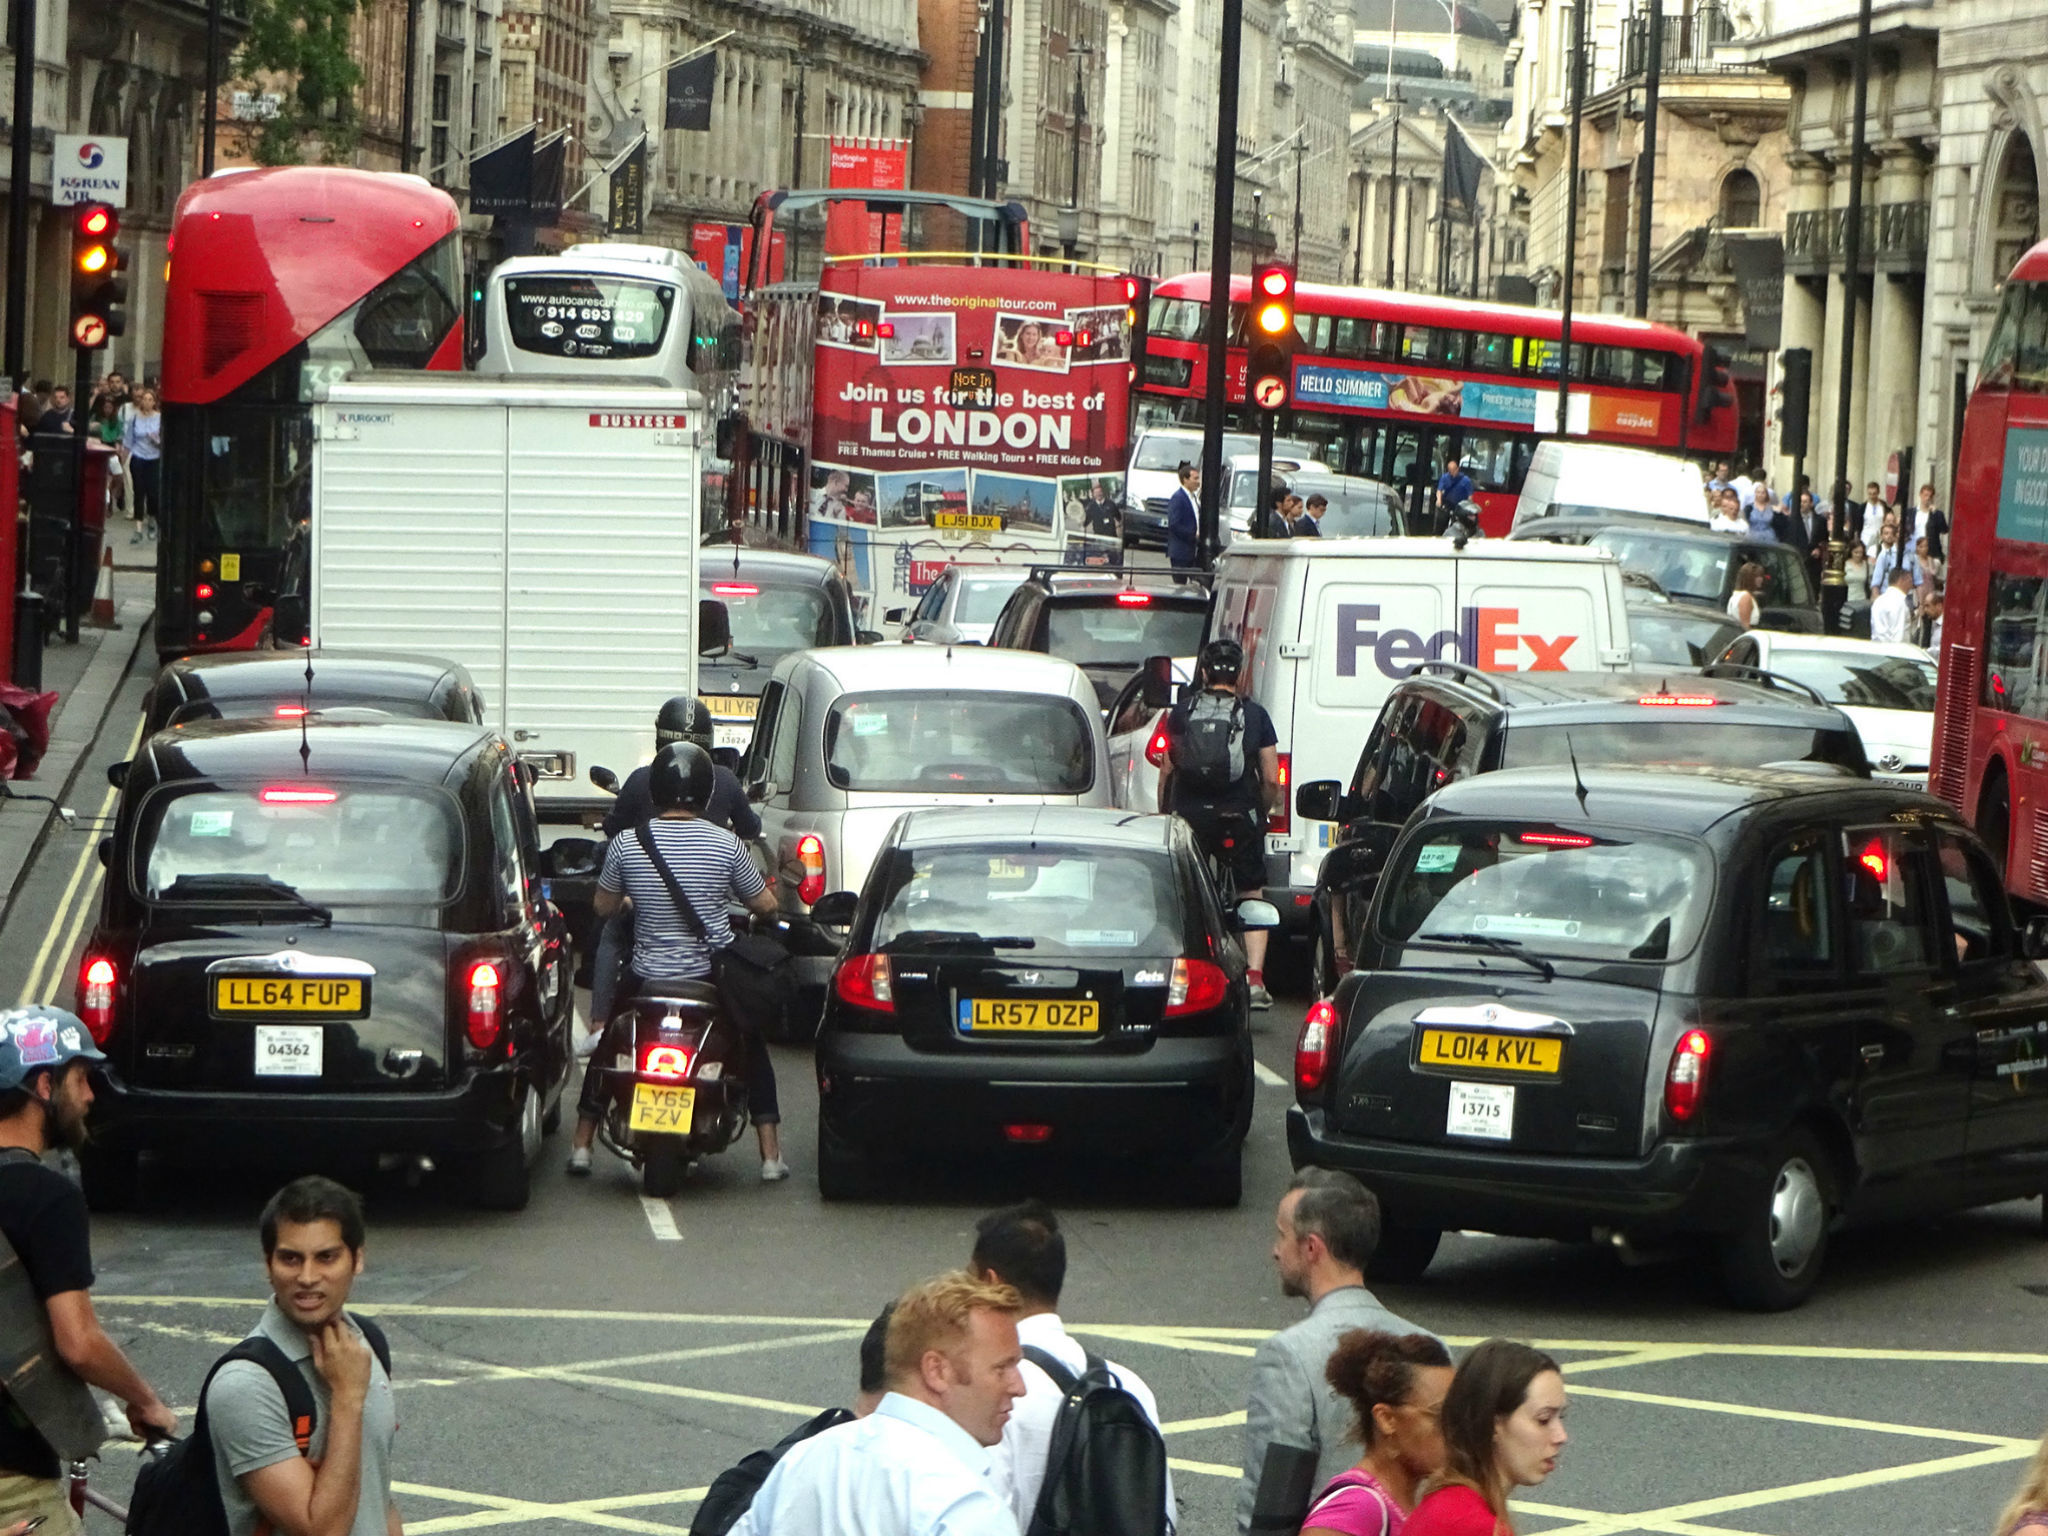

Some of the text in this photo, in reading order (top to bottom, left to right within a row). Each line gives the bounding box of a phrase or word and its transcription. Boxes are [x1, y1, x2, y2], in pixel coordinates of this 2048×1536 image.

[832, 160, 855, 169] House
[60, 177, 120, 190] KOREAN
[62, 191, 90, 201] AIR
[894, 293, 1058, 311] www.theoriginaltour.com
[547, 306, 645, 323] 914 693 429
[953, 372, 992, 388] Not In
[1300, 375, 1382, 398] HELLO SUMMER
[839, 382, 888, 402] Join
[897, 387, 925, 404] us
[933, 386, 968, 406] for
[975, 387, 1014, 408] the
[1022, 389, 1075, 409] best
[1082, 391, 1105, 411] of
[349, 413, 392, 423] FURGOKIT
[600, 414, 676, 429] BUSTESE
[870, 407, 1072, 450] LONDON
[838, 445, 1102, 466] FREE Thames Cruise FREE Walking Tours FREE Kids Cub
[942, 514, 994, 528] LJ51 DJX
[916, 561, 939, 581] The
[1337, 604, 1580, 680] FedEx
[230, 983, 350, 1006] LL64 FUP
[975, 1003, 1039, 1026] LR57
[1046, 1004, 1094, 1027] OZP
[267, 1043, 310, 1056] 04362
[1436, 1034, 1542, 1066] LO14 KVL
[636, 1088, 691, 1109] LY65
[640, 1107, 682, 1126] FZV
[1462, 1103, 1501, 1117] 13715
